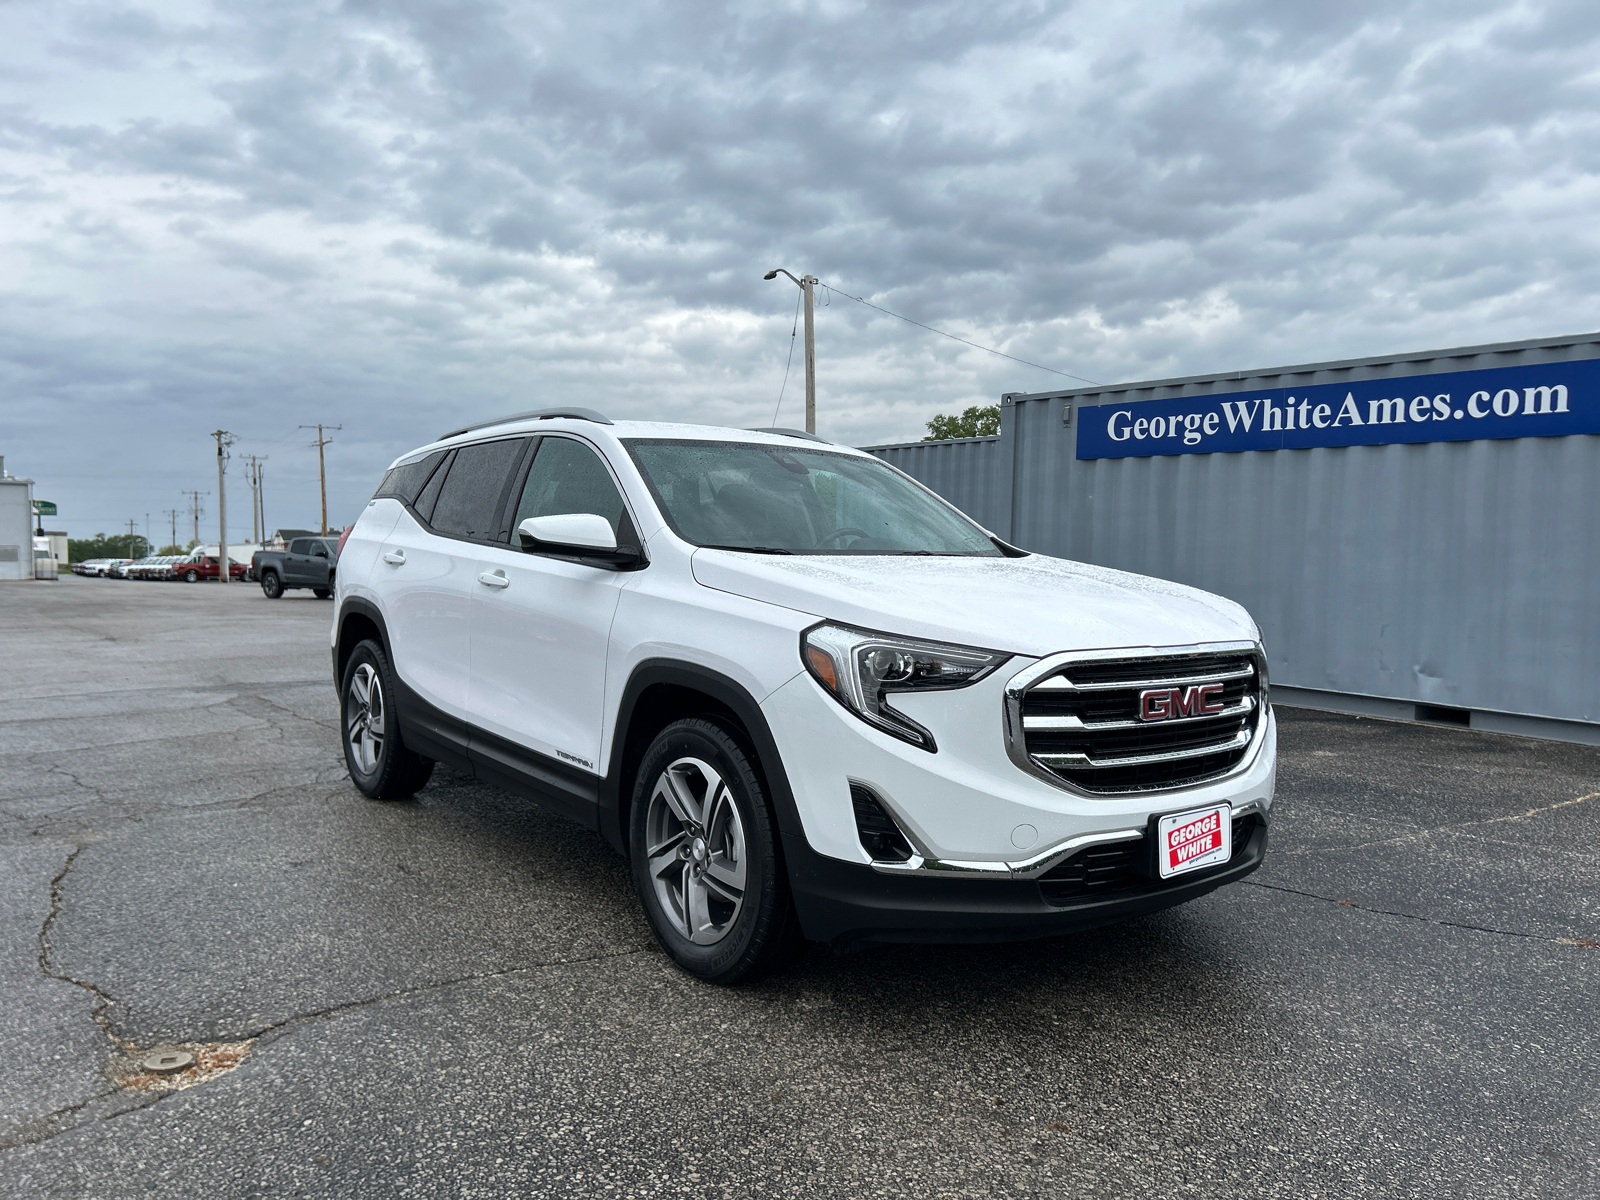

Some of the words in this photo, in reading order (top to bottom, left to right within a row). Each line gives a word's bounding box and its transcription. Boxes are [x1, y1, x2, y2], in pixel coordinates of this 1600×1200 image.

[1107, 384, 1570, 446] GeorgeWhiteAmes.com
[1140, 683, 1224, 721] GMC
[1170, 815, 1218, 846] GEORGE
[1176, 835, 1213, 862] WHITE
